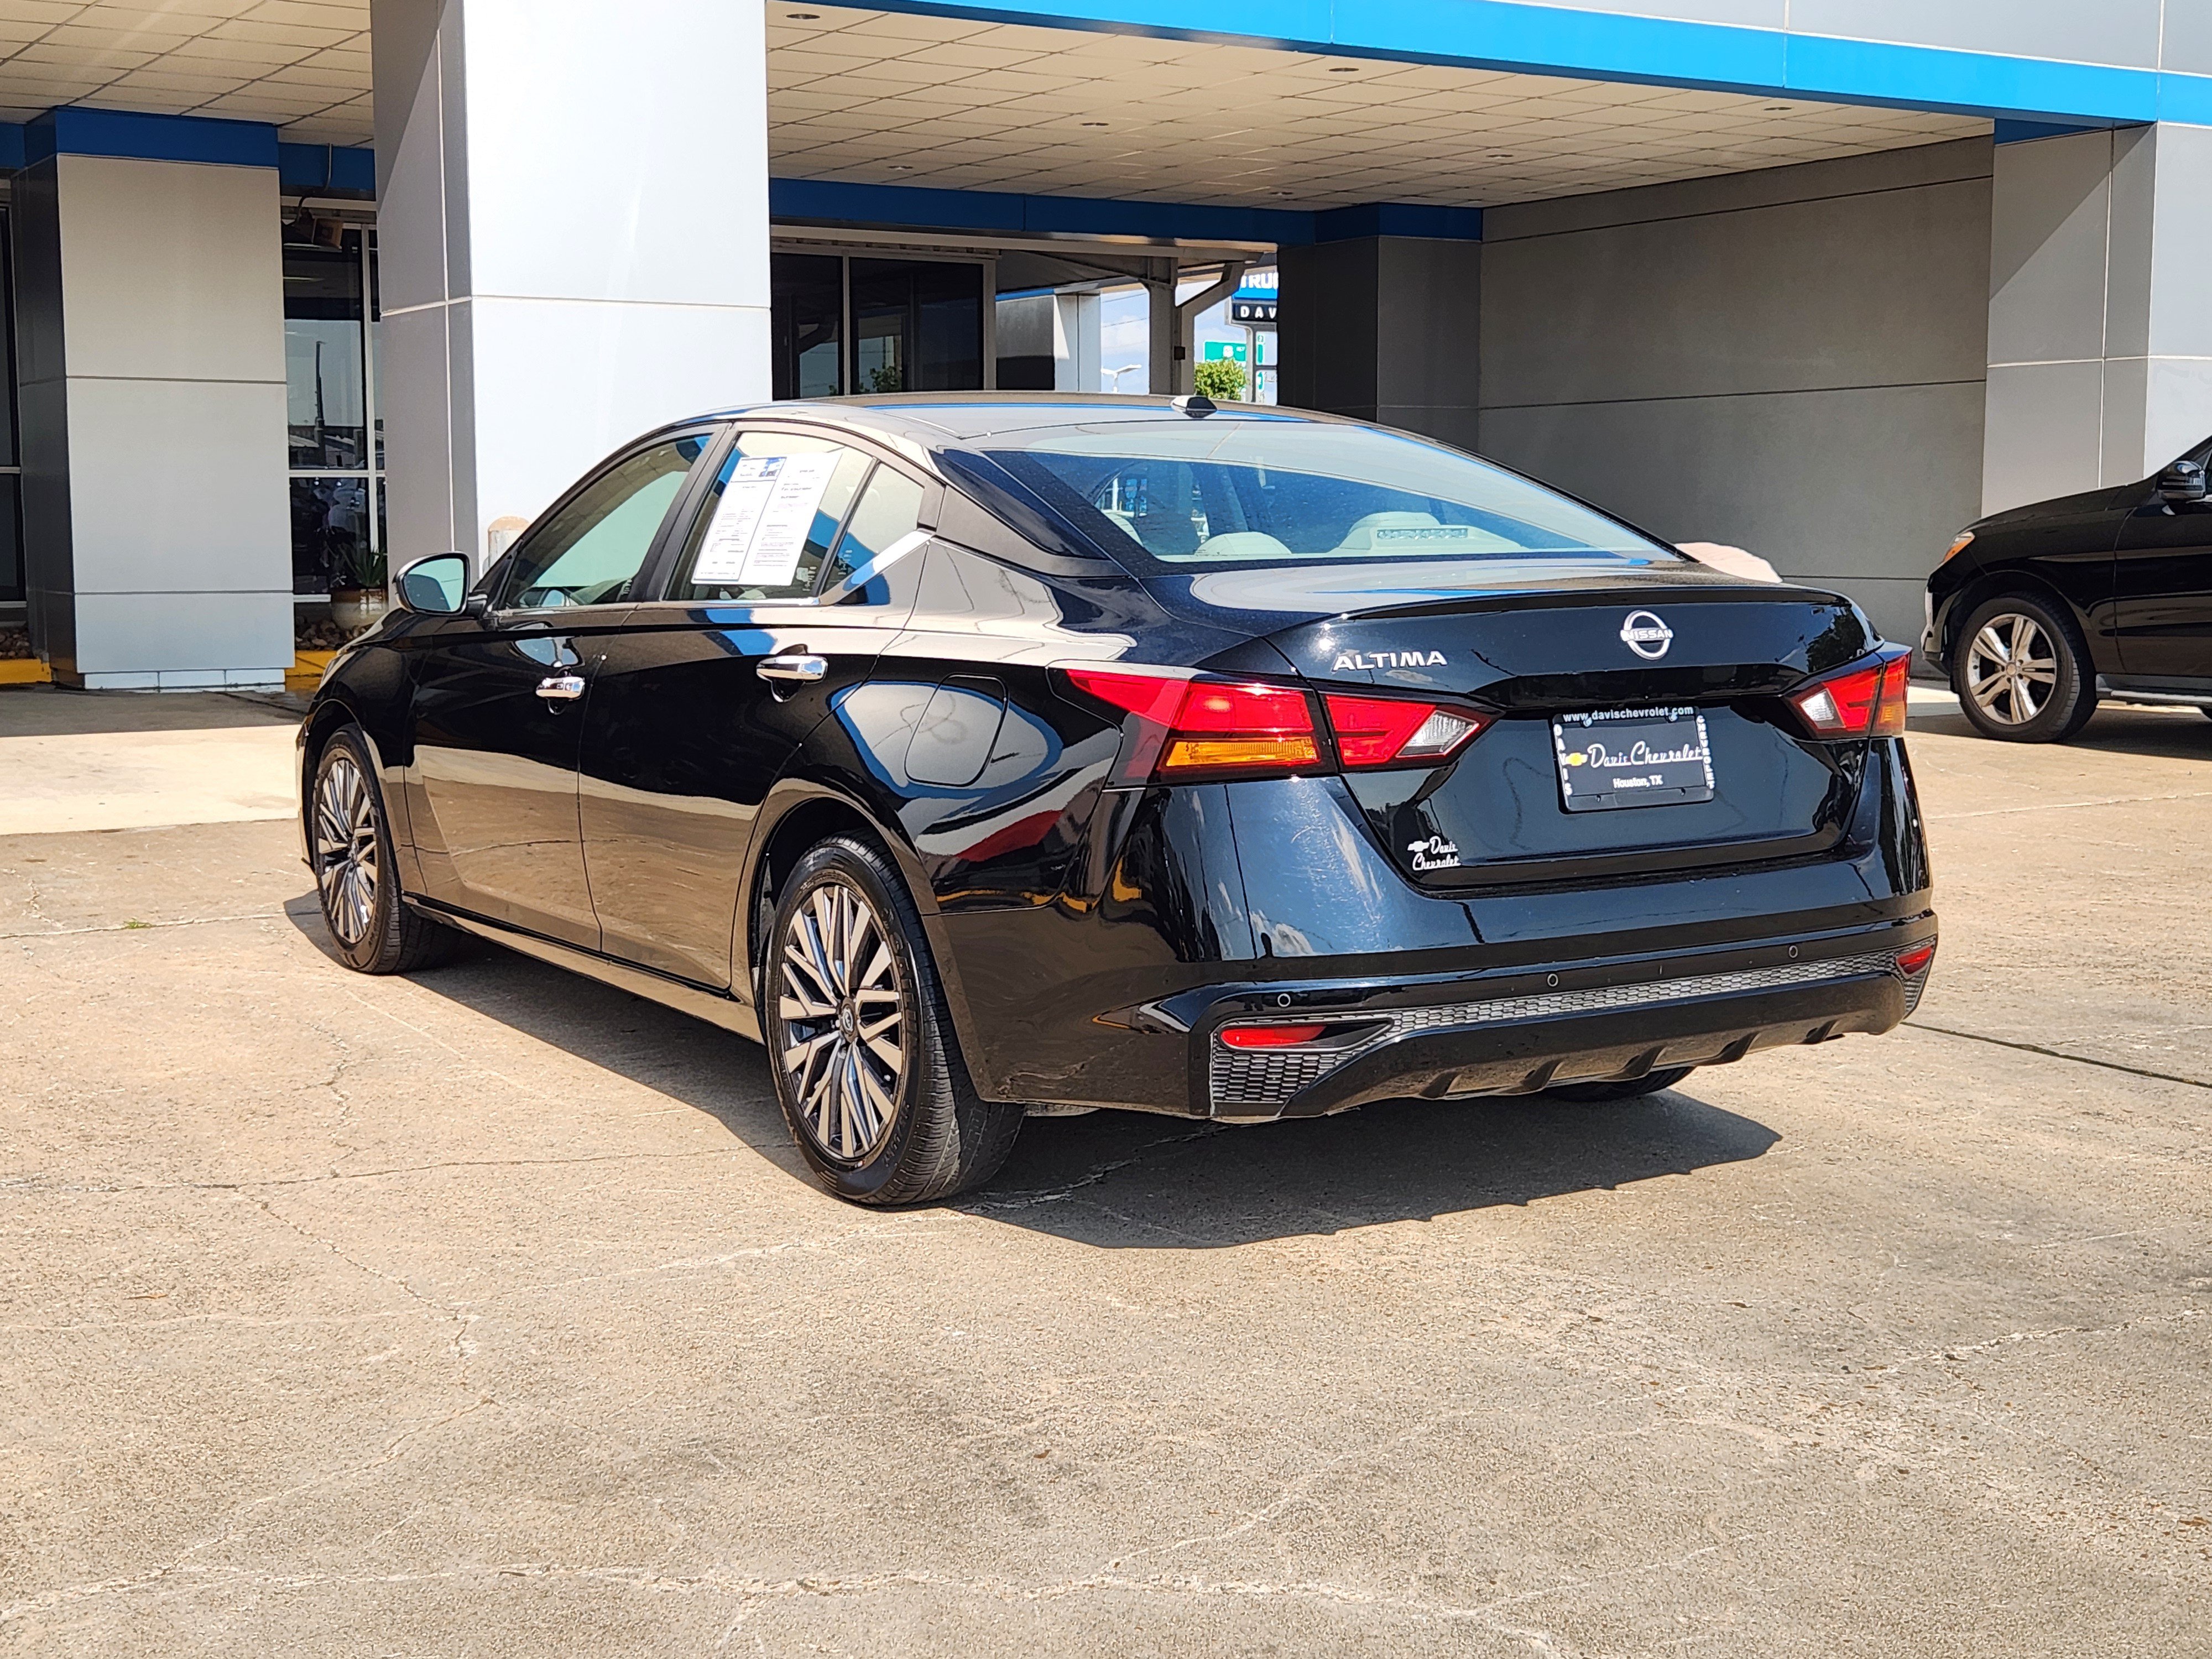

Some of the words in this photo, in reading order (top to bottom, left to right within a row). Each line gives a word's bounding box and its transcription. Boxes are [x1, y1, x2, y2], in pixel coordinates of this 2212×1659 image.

[1623, 629, 1673, 640] NISSAN
[1332, 650, 1448, 671] ALTIMA
[1553, 724, 1573, 796] DAVIS
[1587, 743, 1631, 768] Davis
[1631, 740, 1703, 765] Chevrolet
[1696, 715, 1715, 790] CHEVROLET
[1613, 776, 1650, 789] Houston,
[1648, 774, 1663, 785] TX
[1429, 836, 1459, 854] Davis
[1412, 852, 1462, 871] Chevrolet
